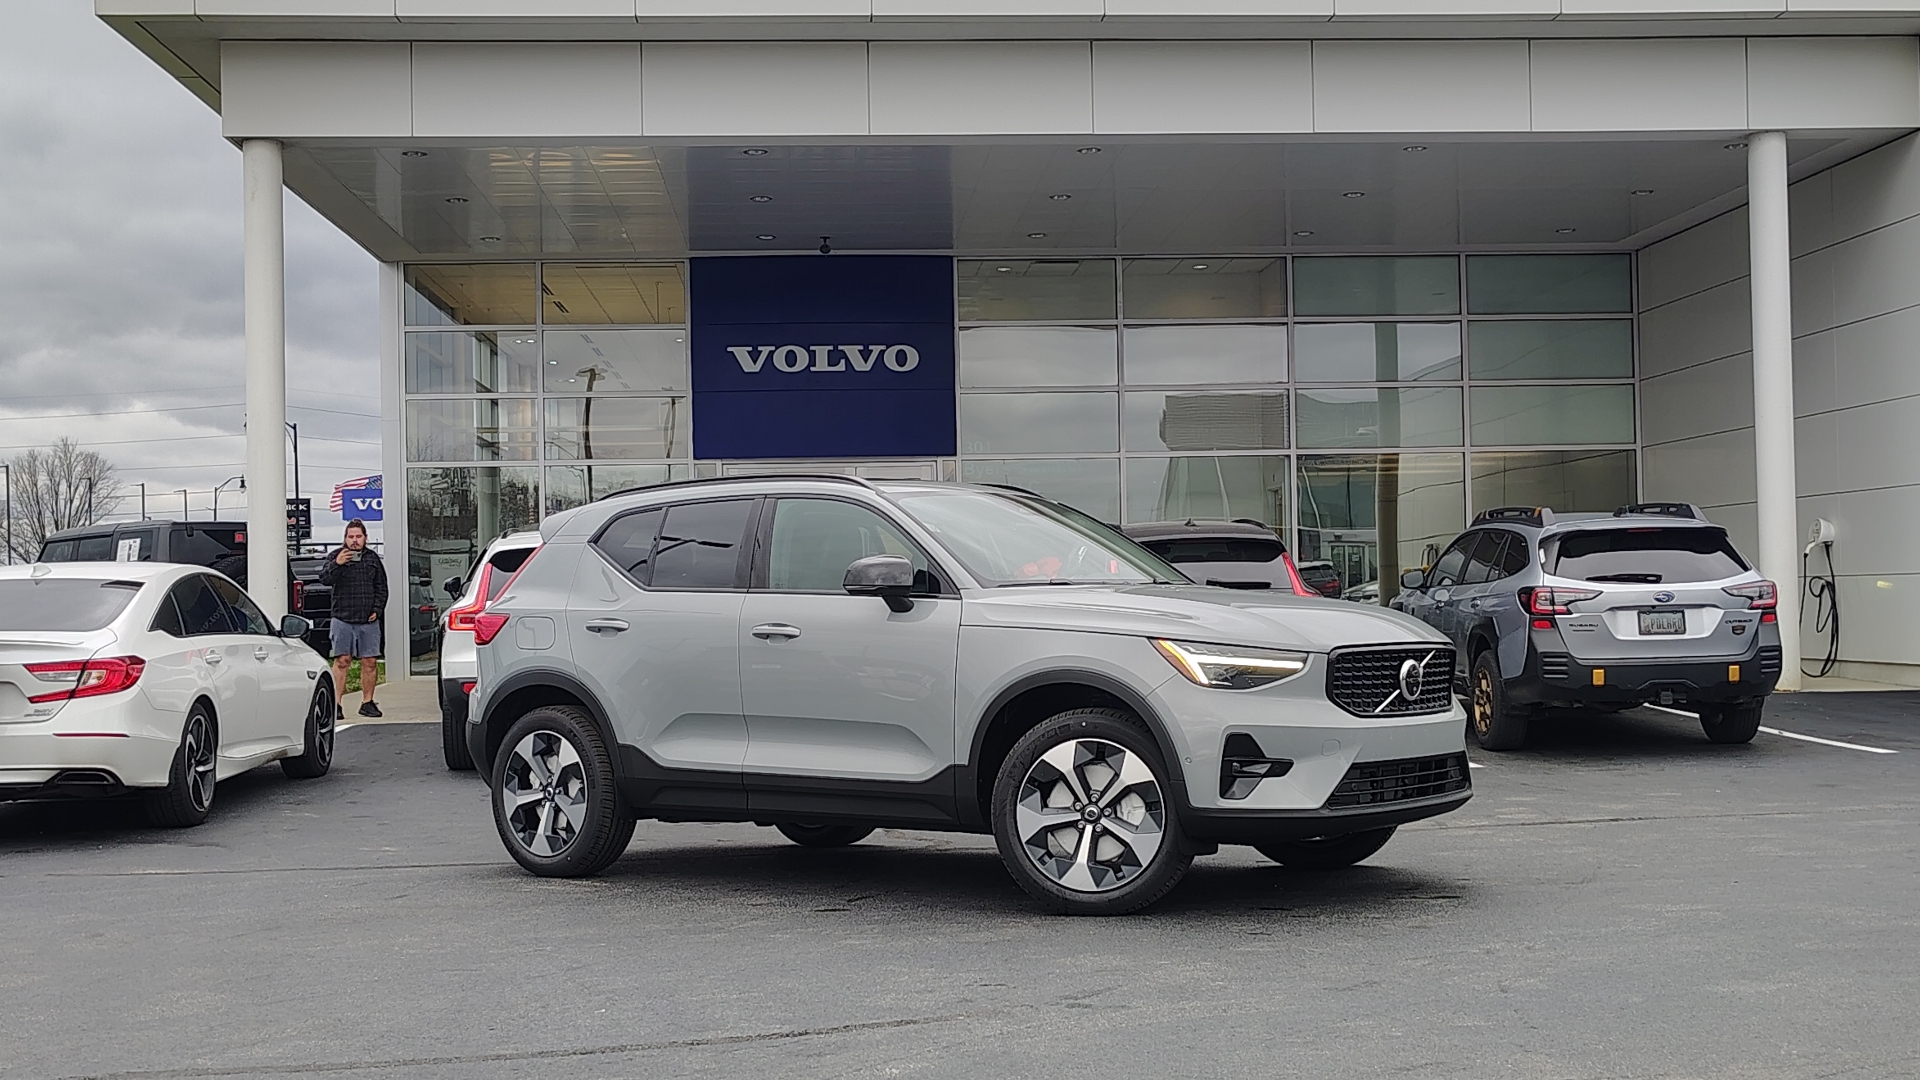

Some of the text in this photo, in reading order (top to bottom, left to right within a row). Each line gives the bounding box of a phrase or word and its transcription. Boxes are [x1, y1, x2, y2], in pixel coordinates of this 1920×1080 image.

[727, 345, 920, 372] VOLVO
[964, 441, 991, 453] 301
[964, 463, 1010, 479] Byers
